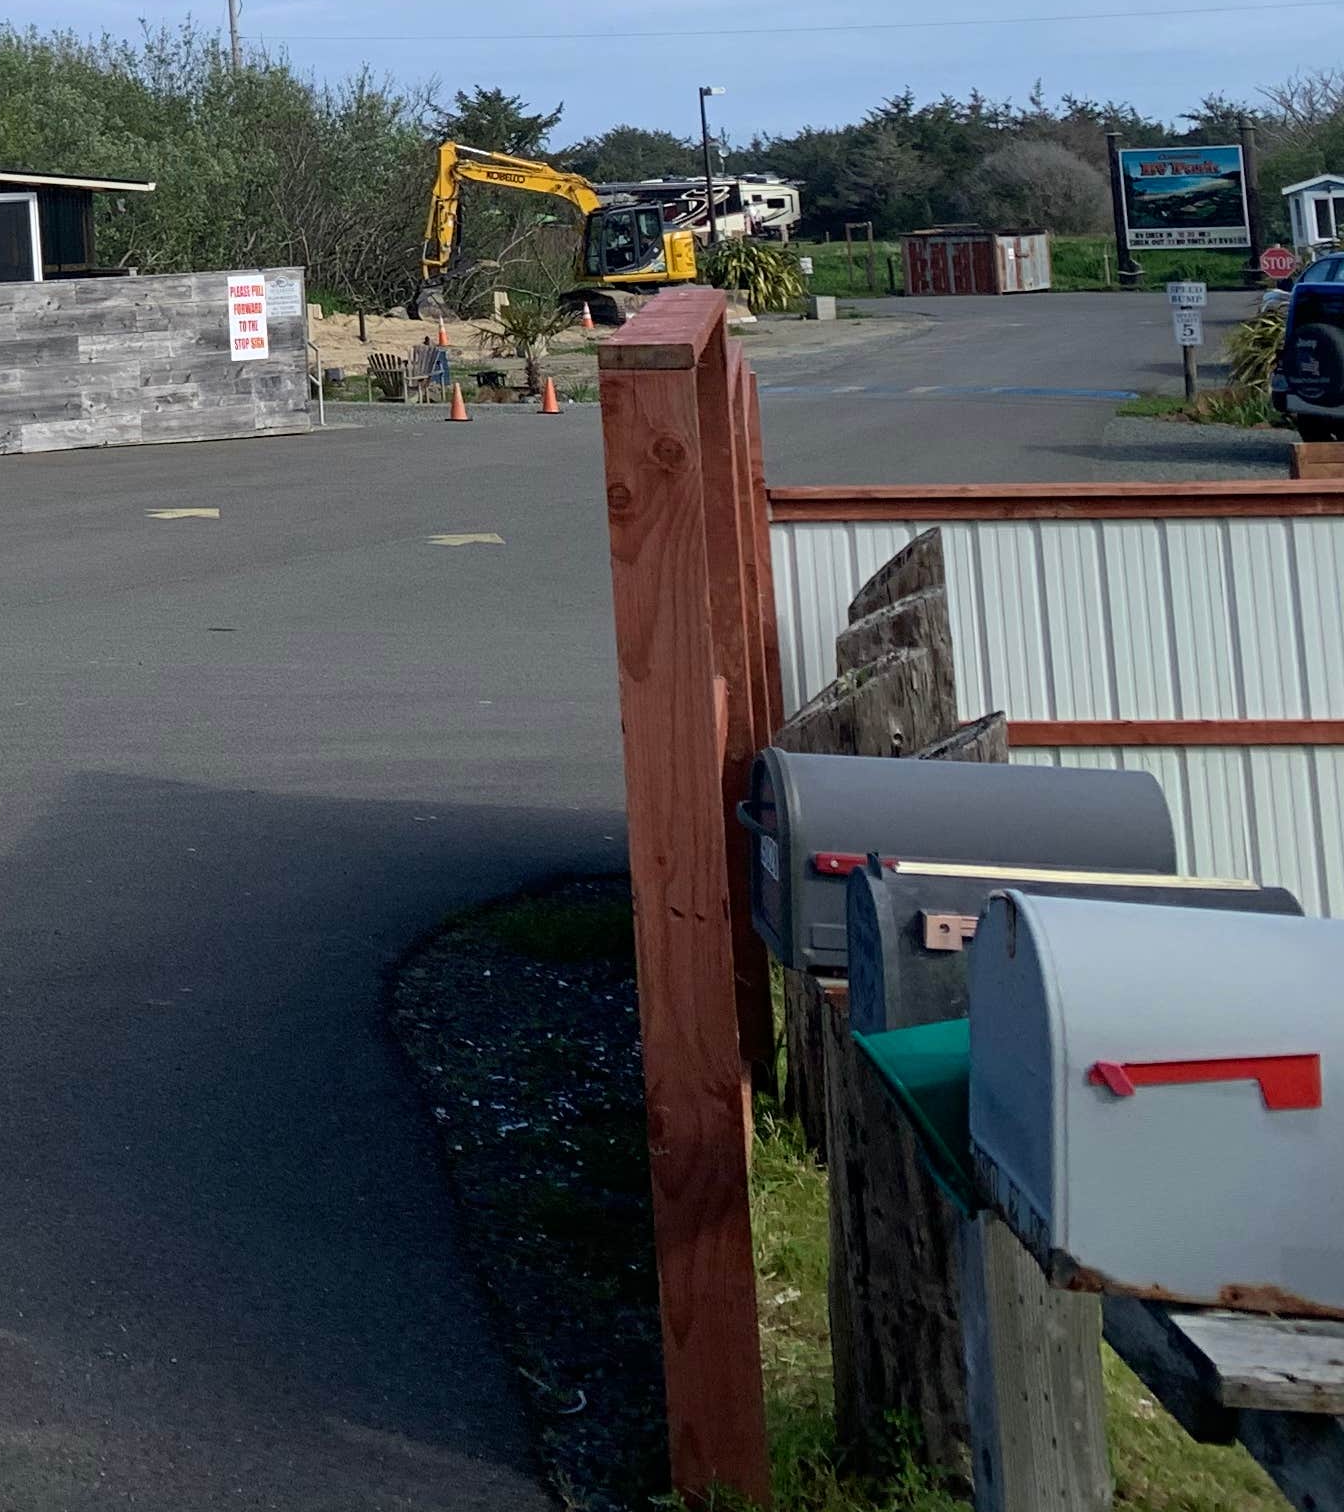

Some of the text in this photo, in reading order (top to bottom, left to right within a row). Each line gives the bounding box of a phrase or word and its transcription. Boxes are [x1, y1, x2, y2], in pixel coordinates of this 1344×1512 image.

[486, 171, 526, 184] KOBELCO
[1263, 256, 1293, 269] STOP
[230, 285, 250, 297] PLEASE
[1171, 285, 1203, 294] SPEED
[1172, 295, 1202, 303] BUMP
[238, 320, 258, 332] TO THE
[1183, 323, 1194, 337] 5
[235, 338, 249, 350] STOP
